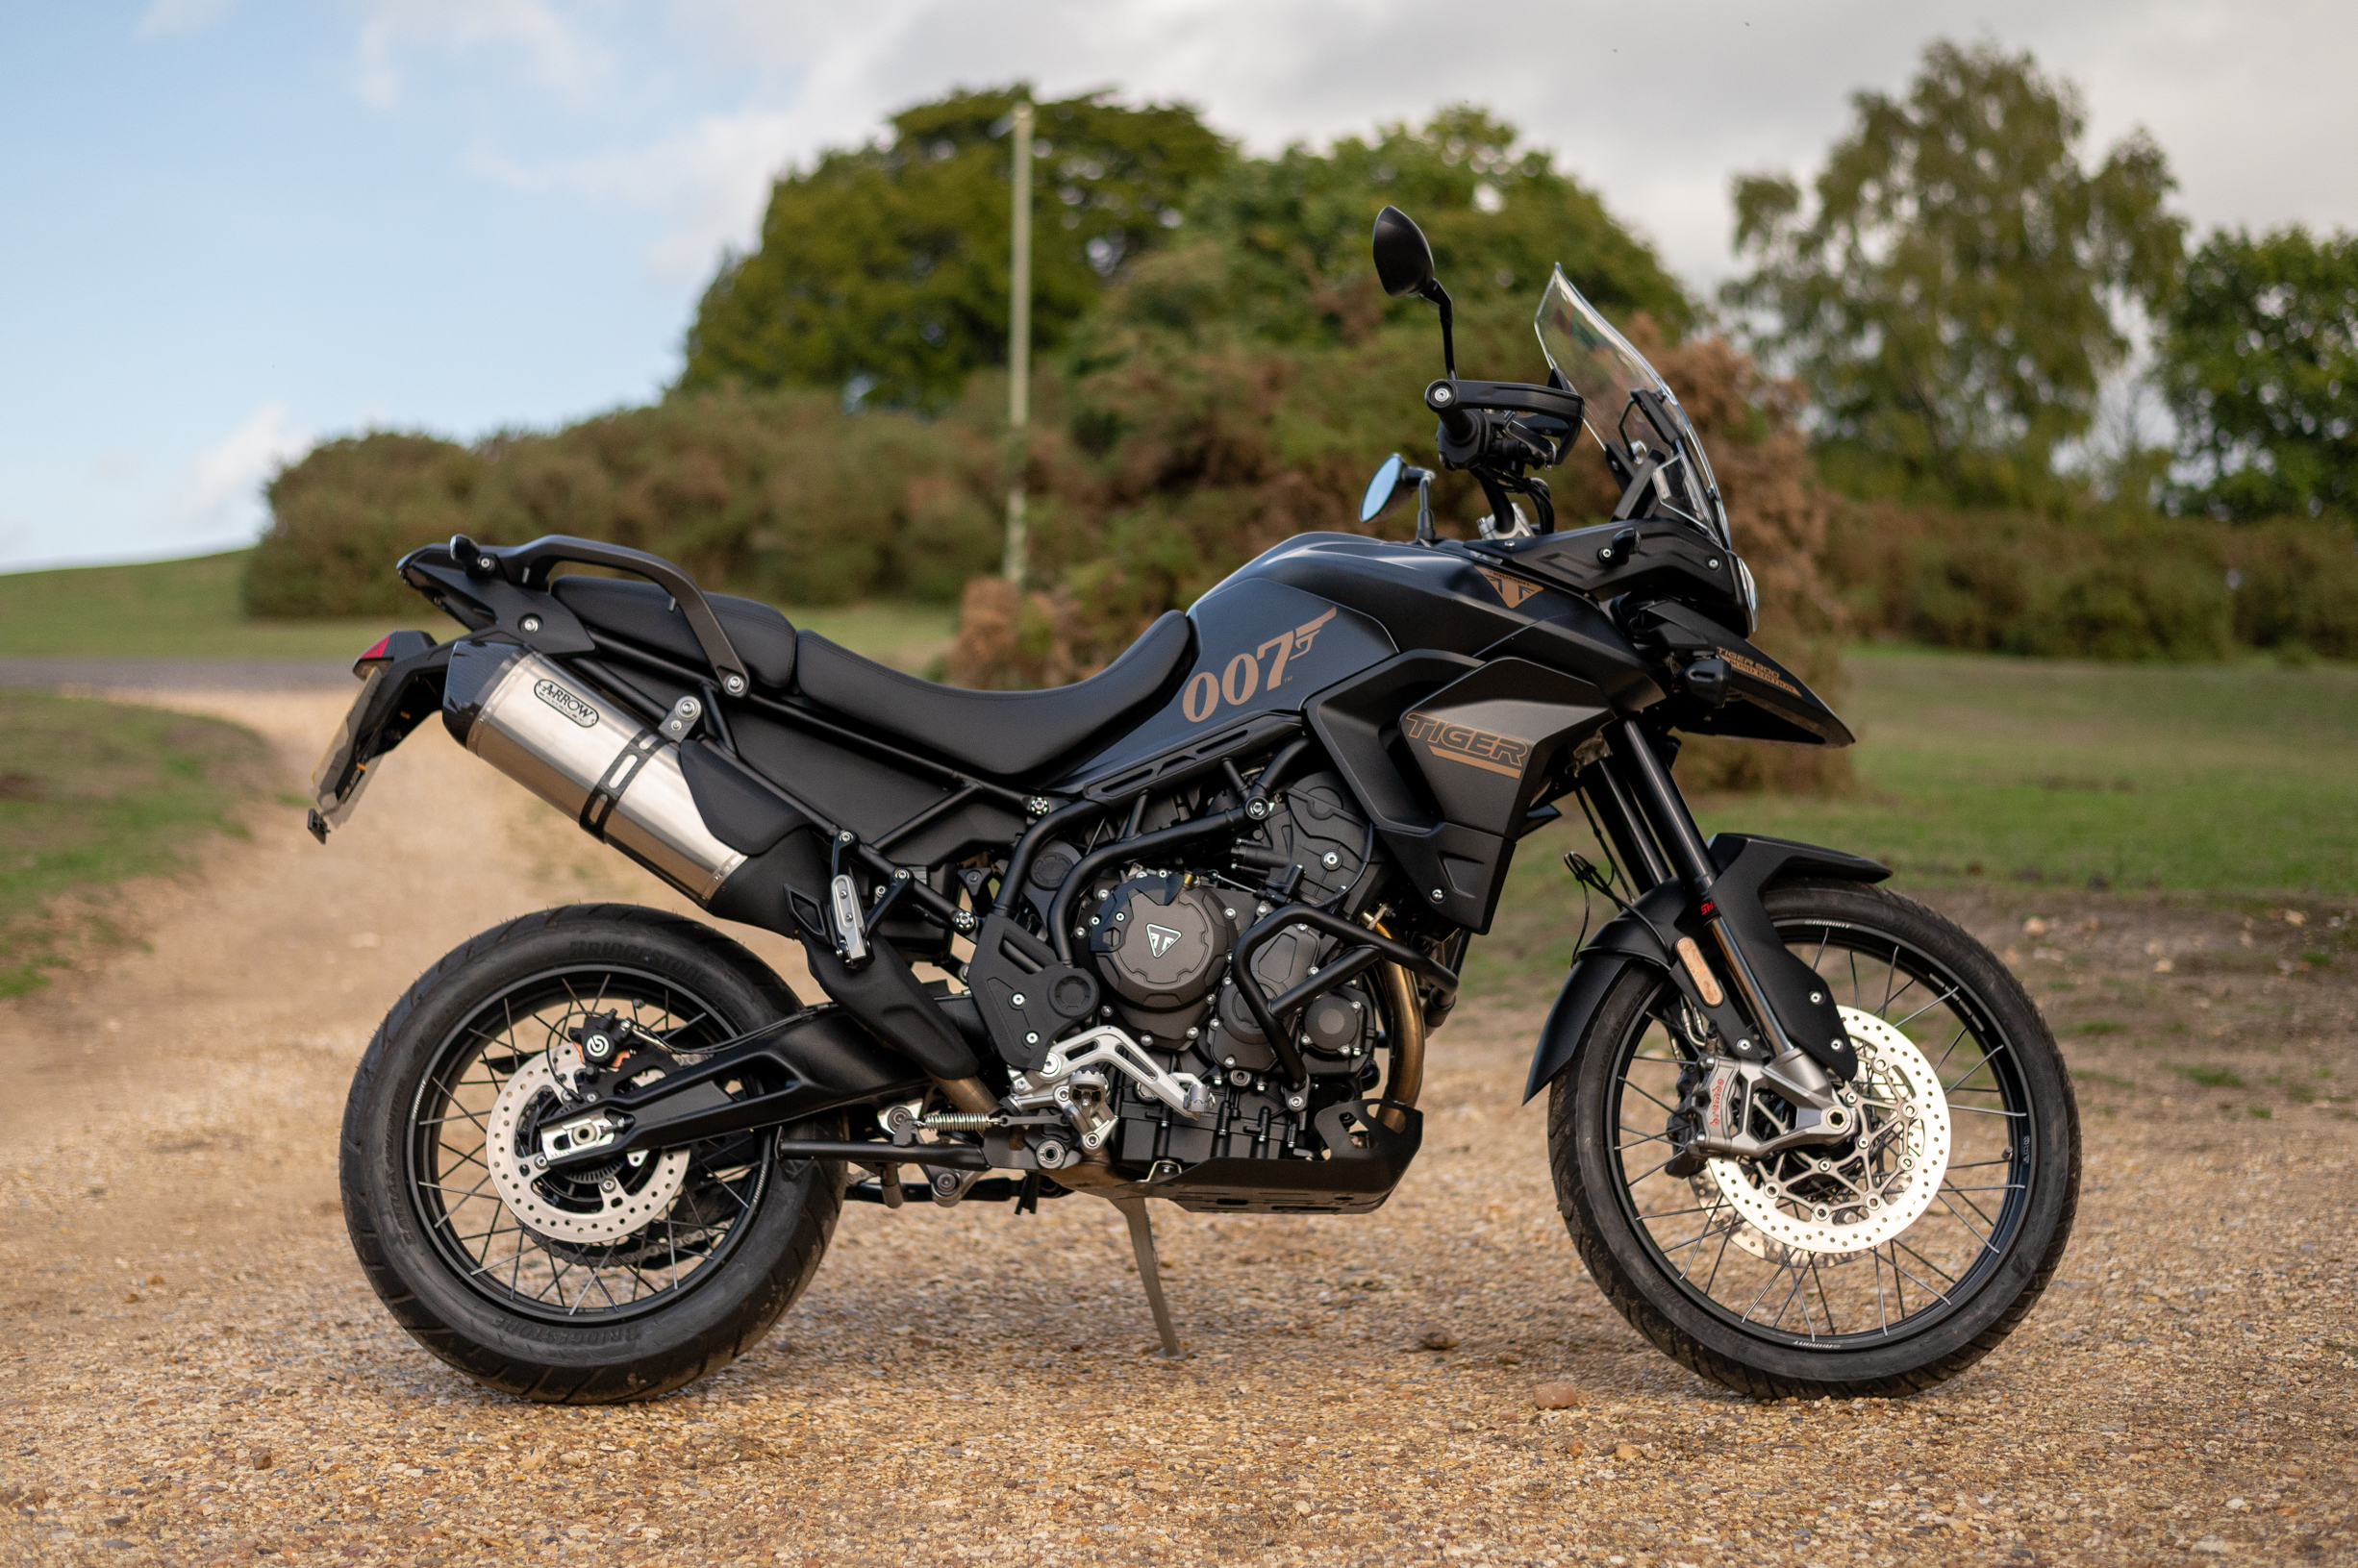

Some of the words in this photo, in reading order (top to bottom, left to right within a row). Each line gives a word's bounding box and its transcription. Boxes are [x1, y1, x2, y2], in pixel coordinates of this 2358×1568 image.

[1182, 630, 1294, 723] 007
[1717, 646, 1754, 669] TIGER
[541, 684, 594, 719] ARROW
[1405, 712, 1528, 767] TIGER
[1710, 1078, 1725, 1126] brembo
